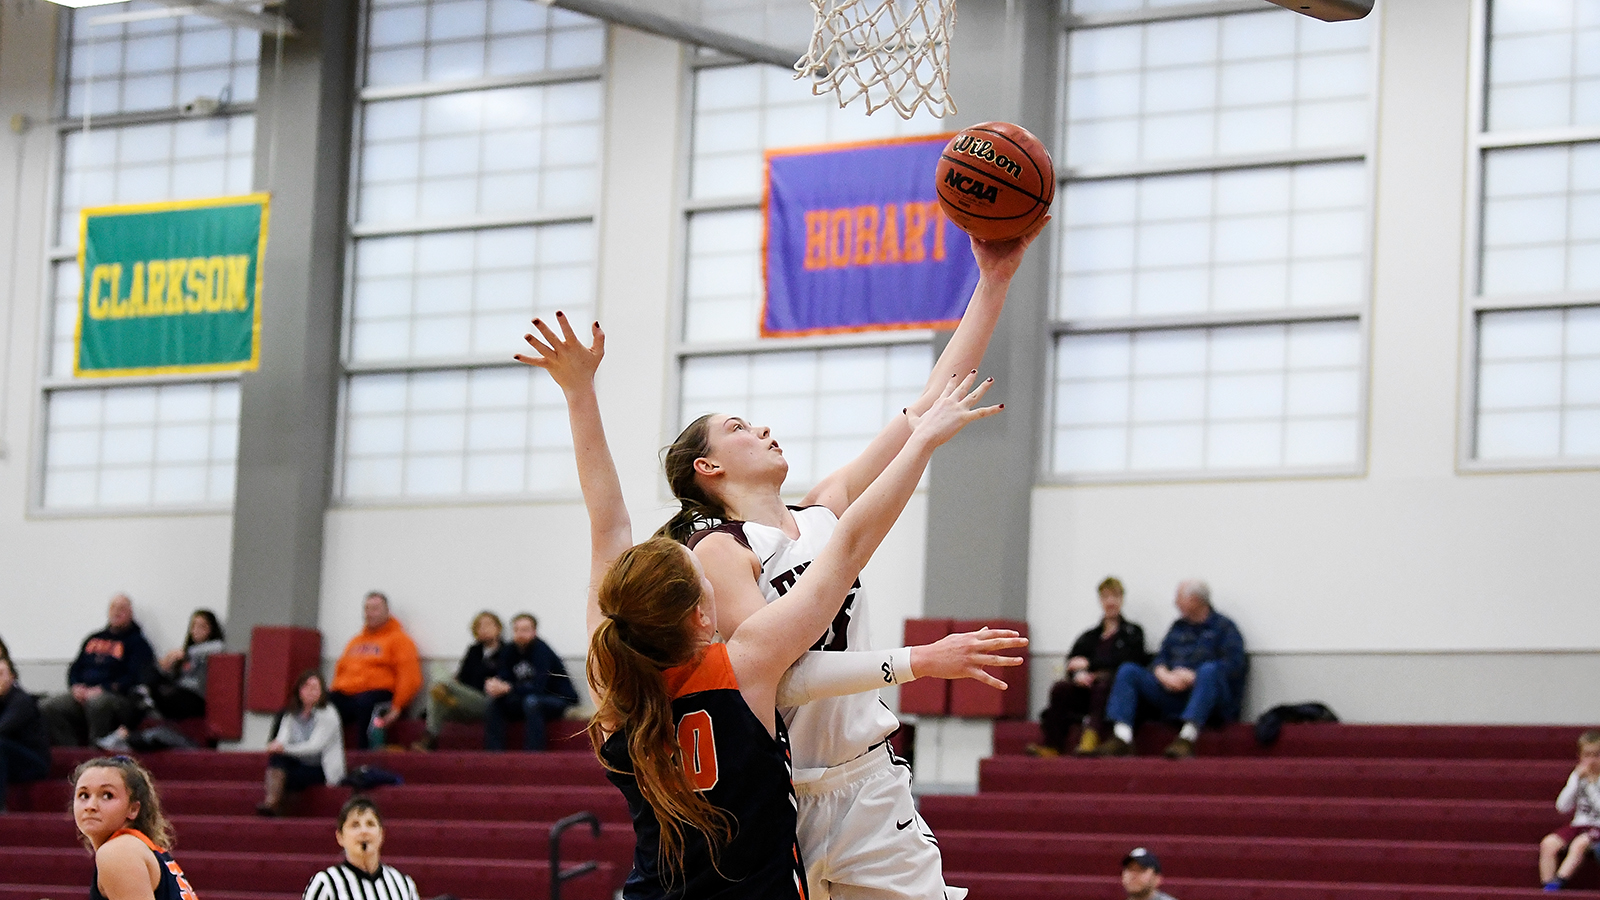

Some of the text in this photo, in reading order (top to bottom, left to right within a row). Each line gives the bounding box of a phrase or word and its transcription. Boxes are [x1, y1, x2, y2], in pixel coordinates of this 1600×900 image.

[944, 168, 998, 204] NCAA
[952, 135, 1023, 179] Wilson
[803, 201, 947, 270] HOBART
[89, 254, 249, 320] CLARKSON
[662, 709, 719, 792] 0
